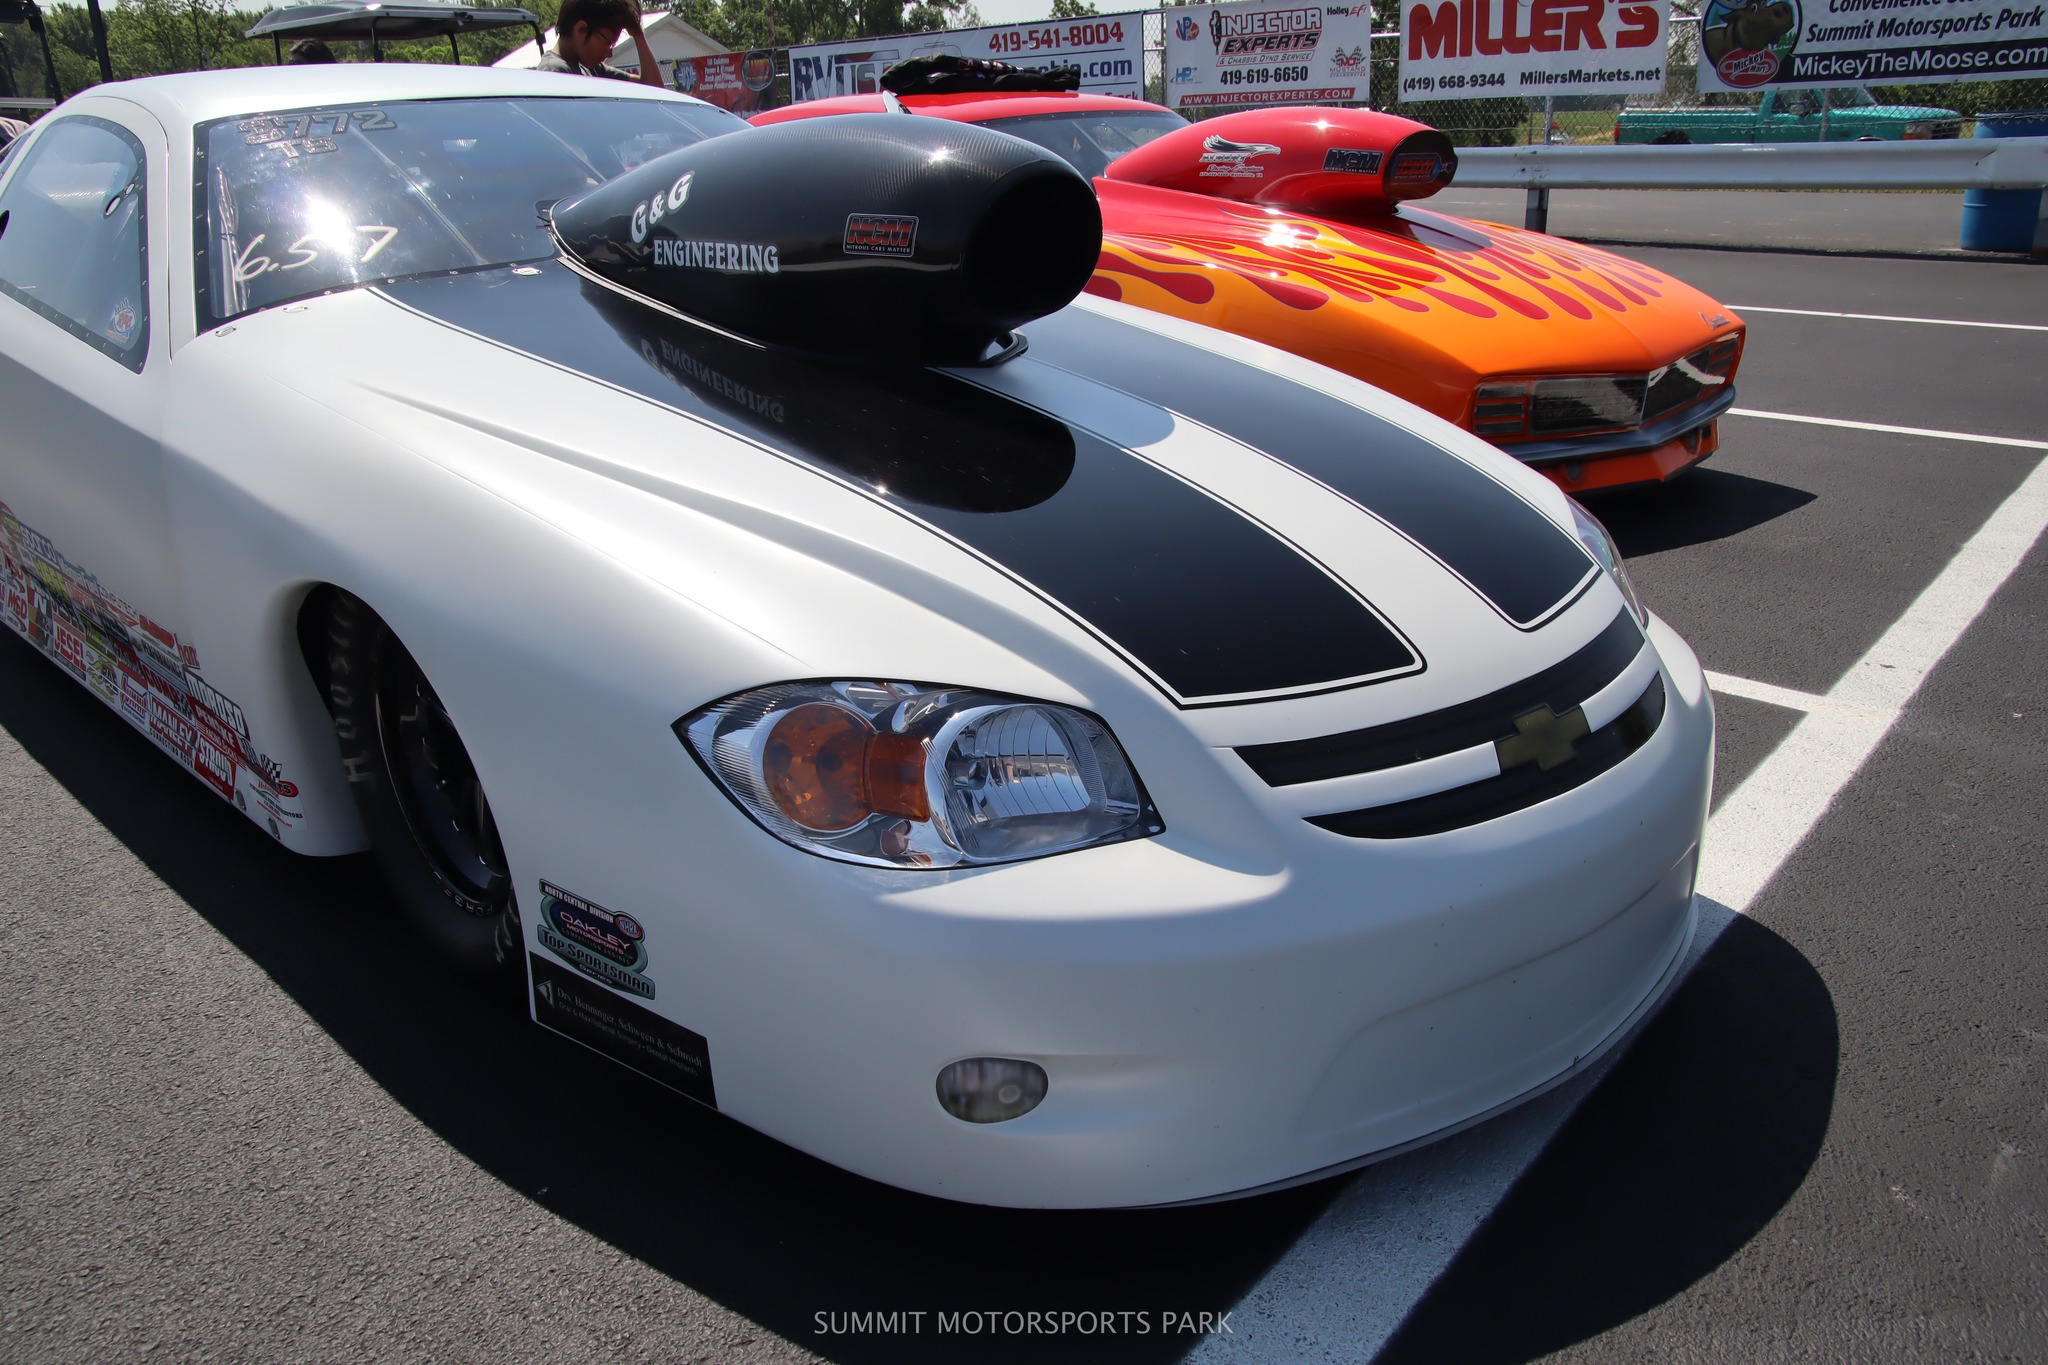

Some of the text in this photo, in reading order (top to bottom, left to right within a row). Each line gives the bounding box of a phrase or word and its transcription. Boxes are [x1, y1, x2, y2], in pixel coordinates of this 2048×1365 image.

[1220, 8, 1322, 37] INJECTOR
[1326, 6, 1349, 17] Holley
[1806, 5, 2046, 43] Summit Motorsports Park
[988, 22, 1124, 53] 419-541-8004
[1176, 16, 1192, 41] VP
[1222, 32, 1321, 54] EXPERTS
[1408, 0, 1660, 61] MILLER'S
[1220, 66, 1309, 86] 419-619-6650
[1793, 47, 2048, 79] MickeyTheMoose.com
[1403, 67, 1661, 94] (419) 668-9344 MillersMarkets.net
[1183, 89, 1351, 105] WWW.INJECTOREXPERTS.COM
[847, 217, 914, 246] NCM
[653, 238, 780, 274] ENGINEERING
[187, 671, 247, 738] MOROSO
[150, 696, 195, 751] MANLEY
[194, 704, 237, 749] PENSKE
[199, 736, 234, 788] STROUD
[544, 884, 614, 924] NORTH CENTRAL DIVISION
[560, 911, 631, 950] OAKLEY
[566, 923, 625, 956] MOTORSPORTS
[579, 963, 613, 985] Series
[656, 1037, 665, 1049] &
